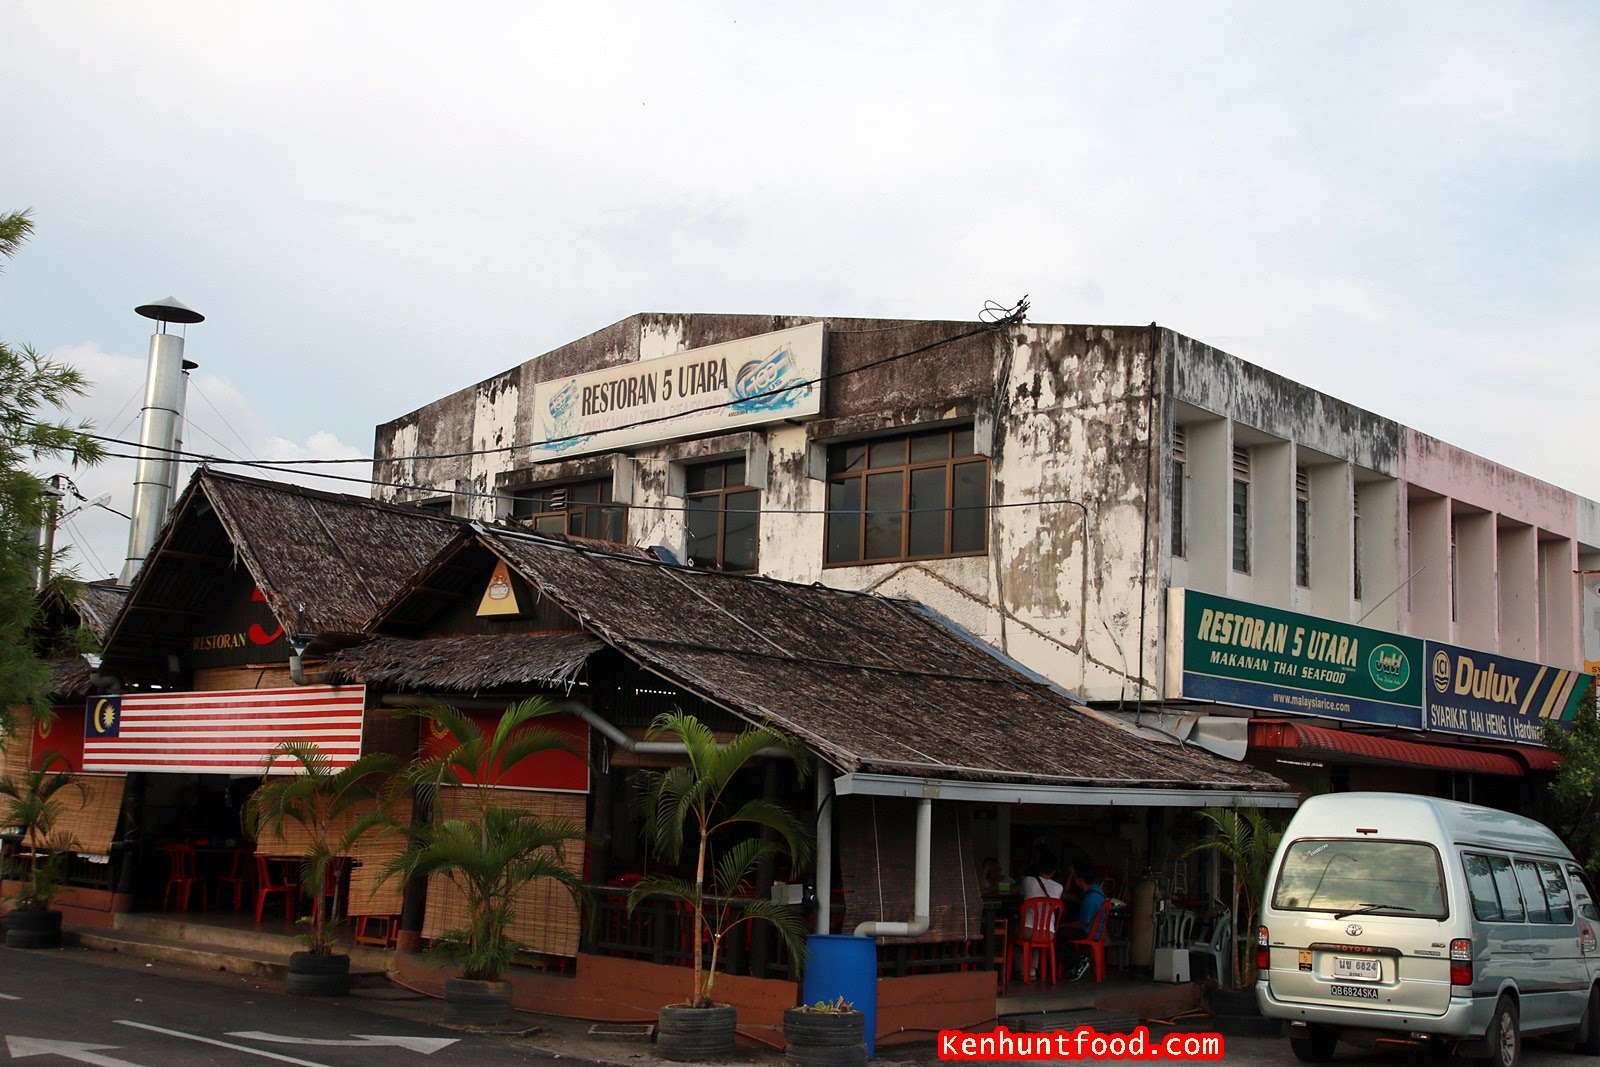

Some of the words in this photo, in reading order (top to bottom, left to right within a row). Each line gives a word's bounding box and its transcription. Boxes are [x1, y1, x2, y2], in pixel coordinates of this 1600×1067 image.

[581, 372, 658, 416] RESTORAN
[662, 369, 673, 401] 5
[678, 357, 729, 398] UTARA
[192, 633, 247, 651] RESTORAN
[1197, 608, 1289, 654] RESTORAN
[1291, 627, 1306, 657] 5
[1307, 630, 1359, 667] UTARA
[1209, 651, 1270, 671] MAKANAN
[1273, 661, 1298, 676] THAI
[1301, 666, 1347, 684] SEAFOOD
[1436, 659, 1448, 675] ICI
[1454, 655, 1520, 705] Dulux
[1272, 692, 1351, 713] www.malaysiarice.com
[1431, 704, 1468, 731] SYARIKAT
[1470, 710, 1485, 733] HAI
[1486, 713, 1508, 736] HENG
[1336, 945, 1373, 953] TOYOTA
[1355, 961, 1377, 971] 6824
[1331, 985, 1378, 999] QB6824SKA
